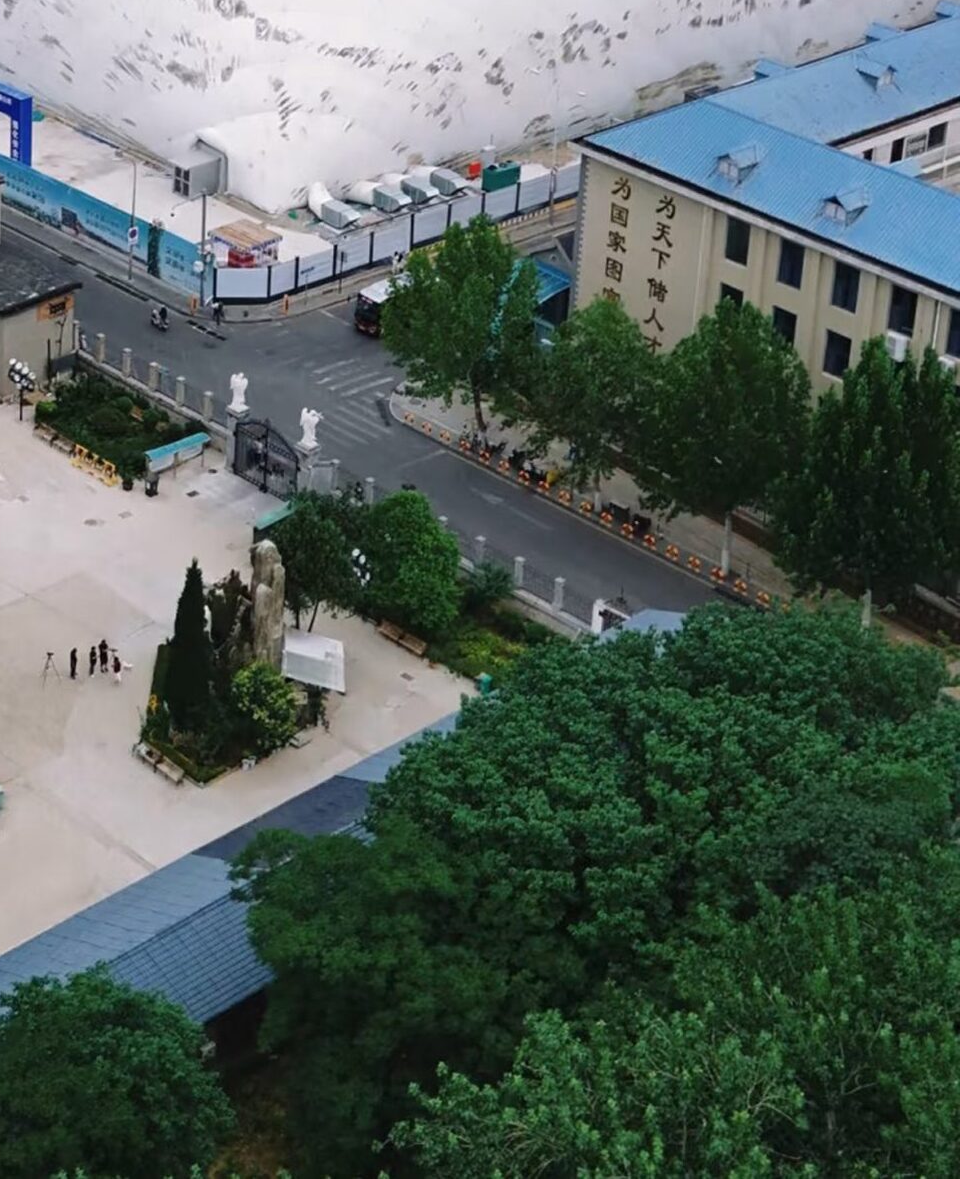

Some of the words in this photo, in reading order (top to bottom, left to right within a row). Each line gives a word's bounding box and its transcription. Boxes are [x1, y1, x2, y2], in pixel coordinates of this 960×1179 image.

[643, 195, 676, 354] 为天下储人才
